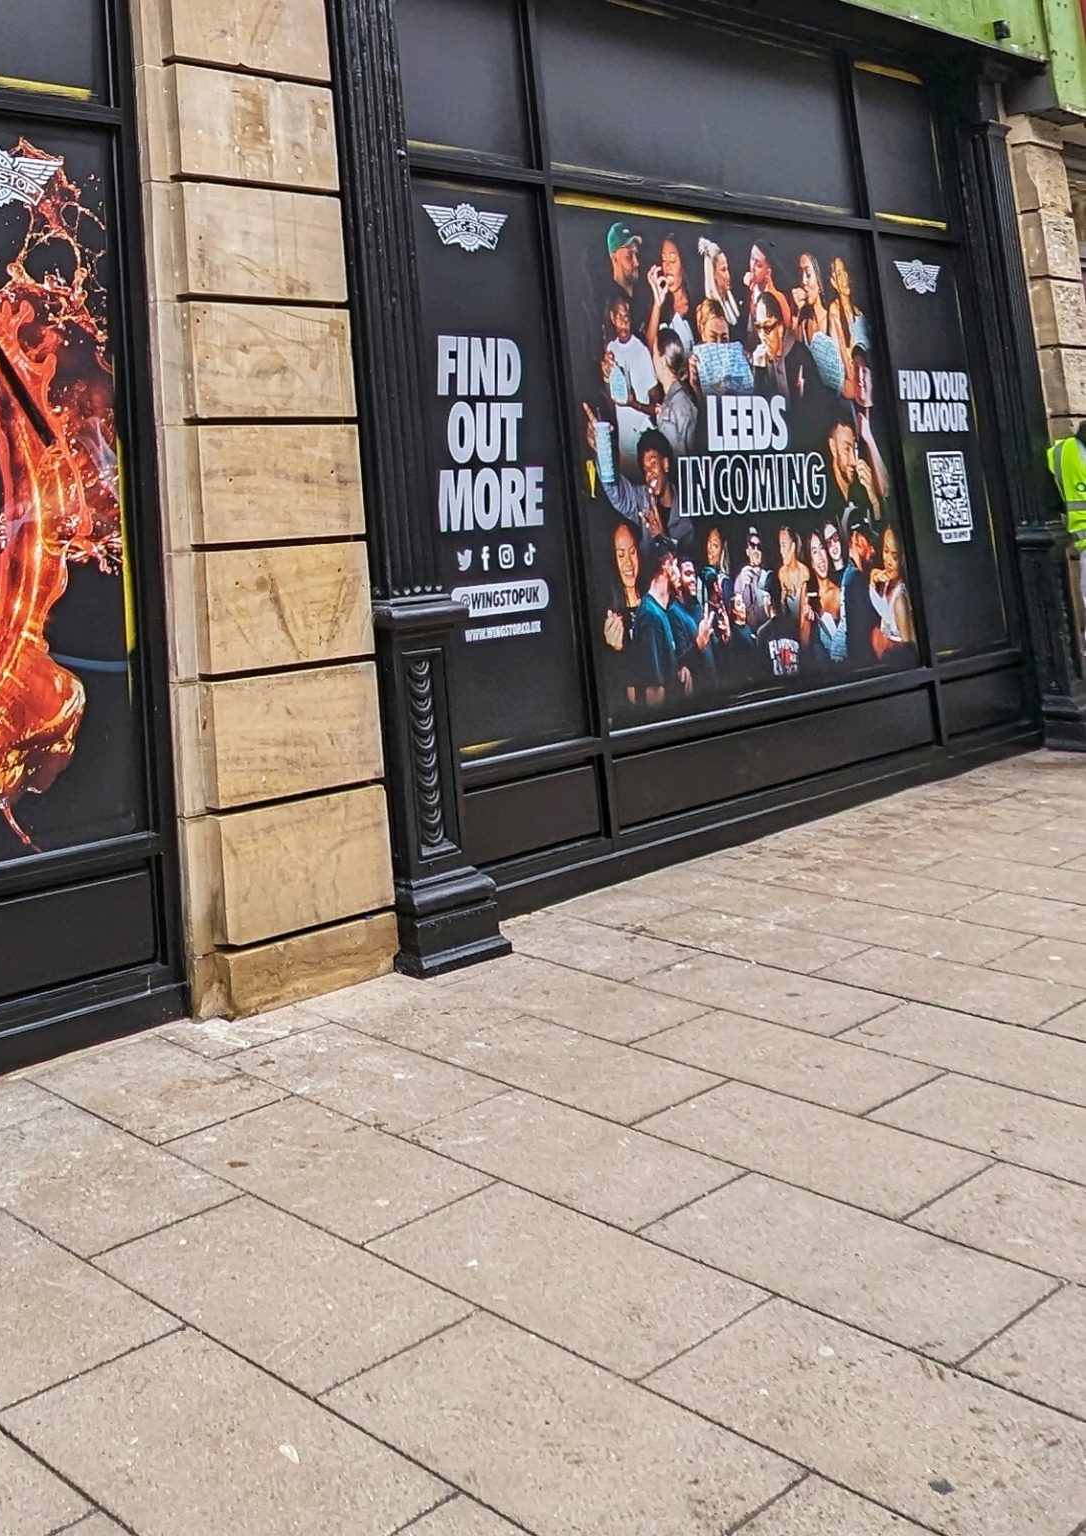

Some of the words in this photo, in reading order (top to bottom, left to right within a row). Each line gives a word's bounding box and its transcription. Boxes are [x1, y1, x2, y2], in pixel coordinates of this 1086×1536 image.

[437, 335, 521, 396] FIND
[898, 370, 931, 400] FIND
[931, 370, 970, 401] YOUR
[447, 401, 523, 464] OUT
[706, 394, 789, 452] LEEDS
[908, 402, 970, 432] FLAVOUR
[438, 467, 544, 533] MORE
[678, 452, 827, 517] INCOMING
[460, 586, 541, 610] @WINGSTOPUK
